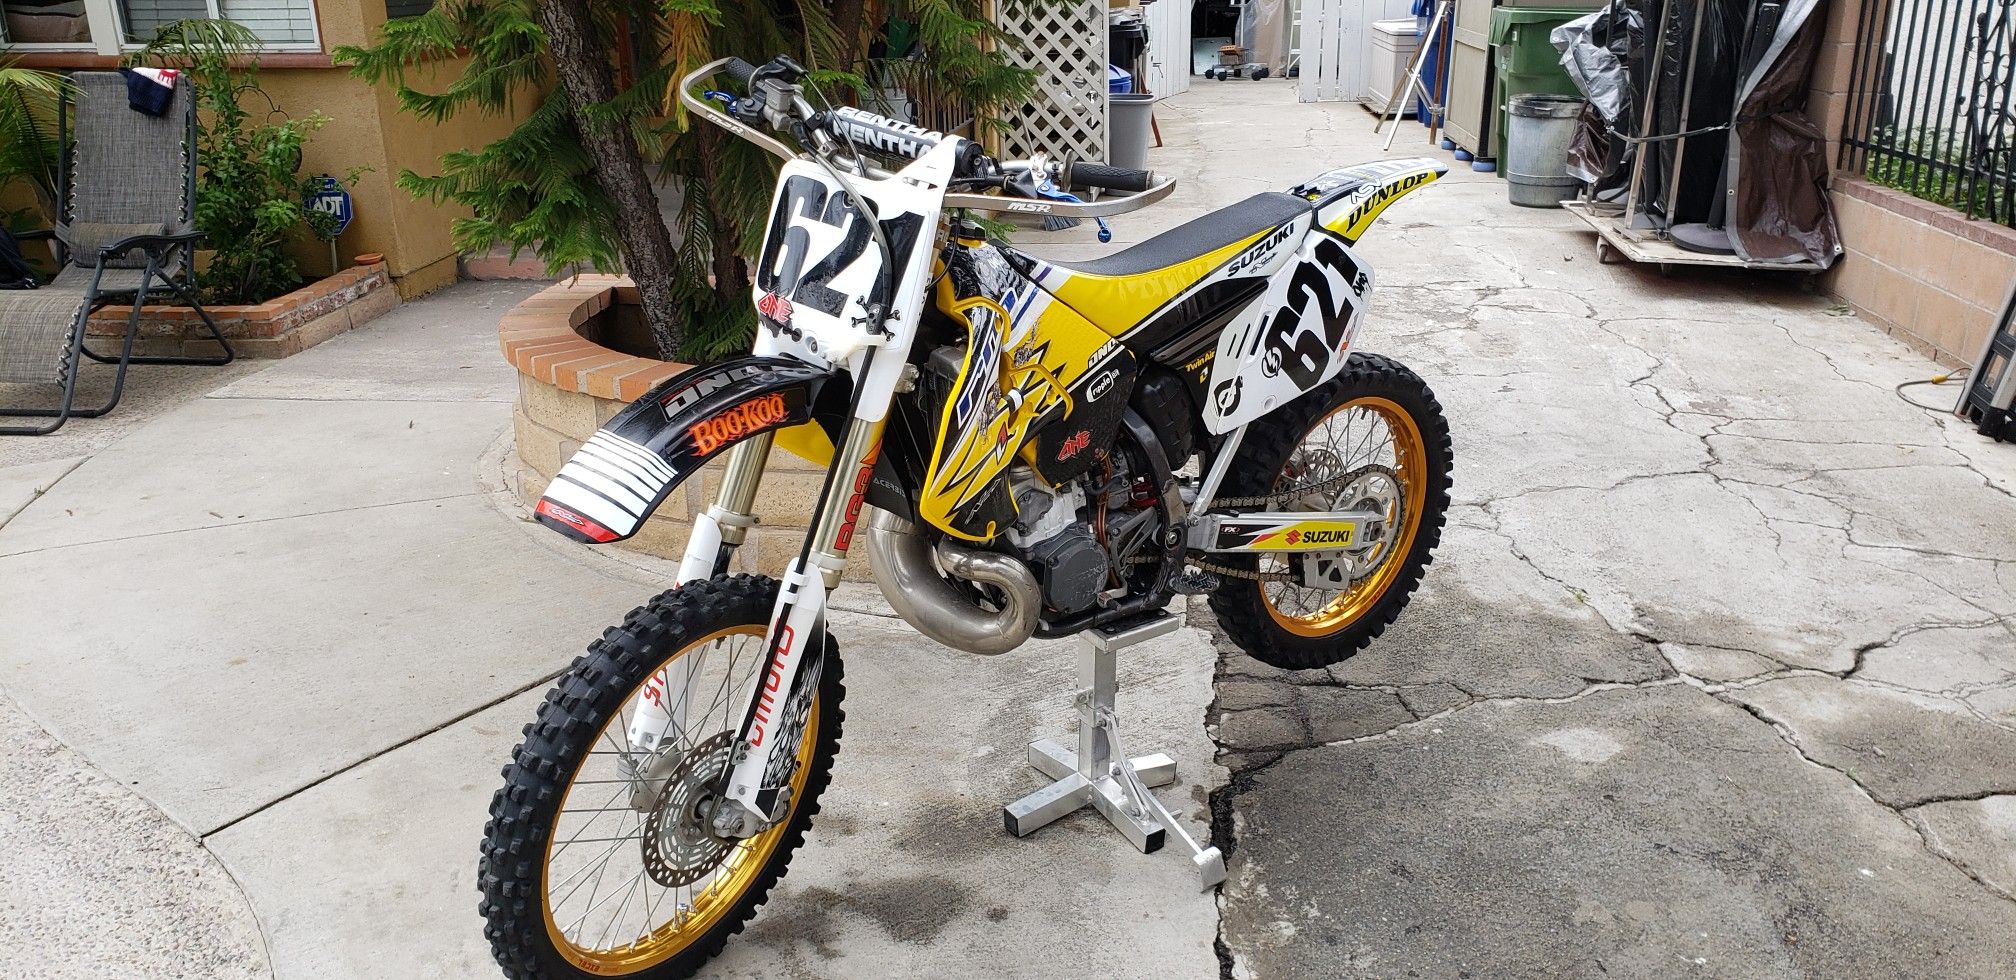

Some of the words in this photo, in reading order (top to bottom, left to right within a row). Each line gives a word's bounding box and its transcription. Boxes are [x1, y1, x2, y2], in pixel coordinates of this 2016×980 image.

[706, 112, 746, 135] MSR
[839, 106, 943, 142] RENTHA
[313, 196, 343, 216] ADT
[1007, 202, 1052, 213] MSR
[1346, 172, 1429, 233] DUNLOP
[758, 175, 925, 318] 621
[1227, 222, 1295, 278] SUZUKI
[1264, 238, 1358, 392] 621
[1302, 530, 1350, 543] SUZUKI
